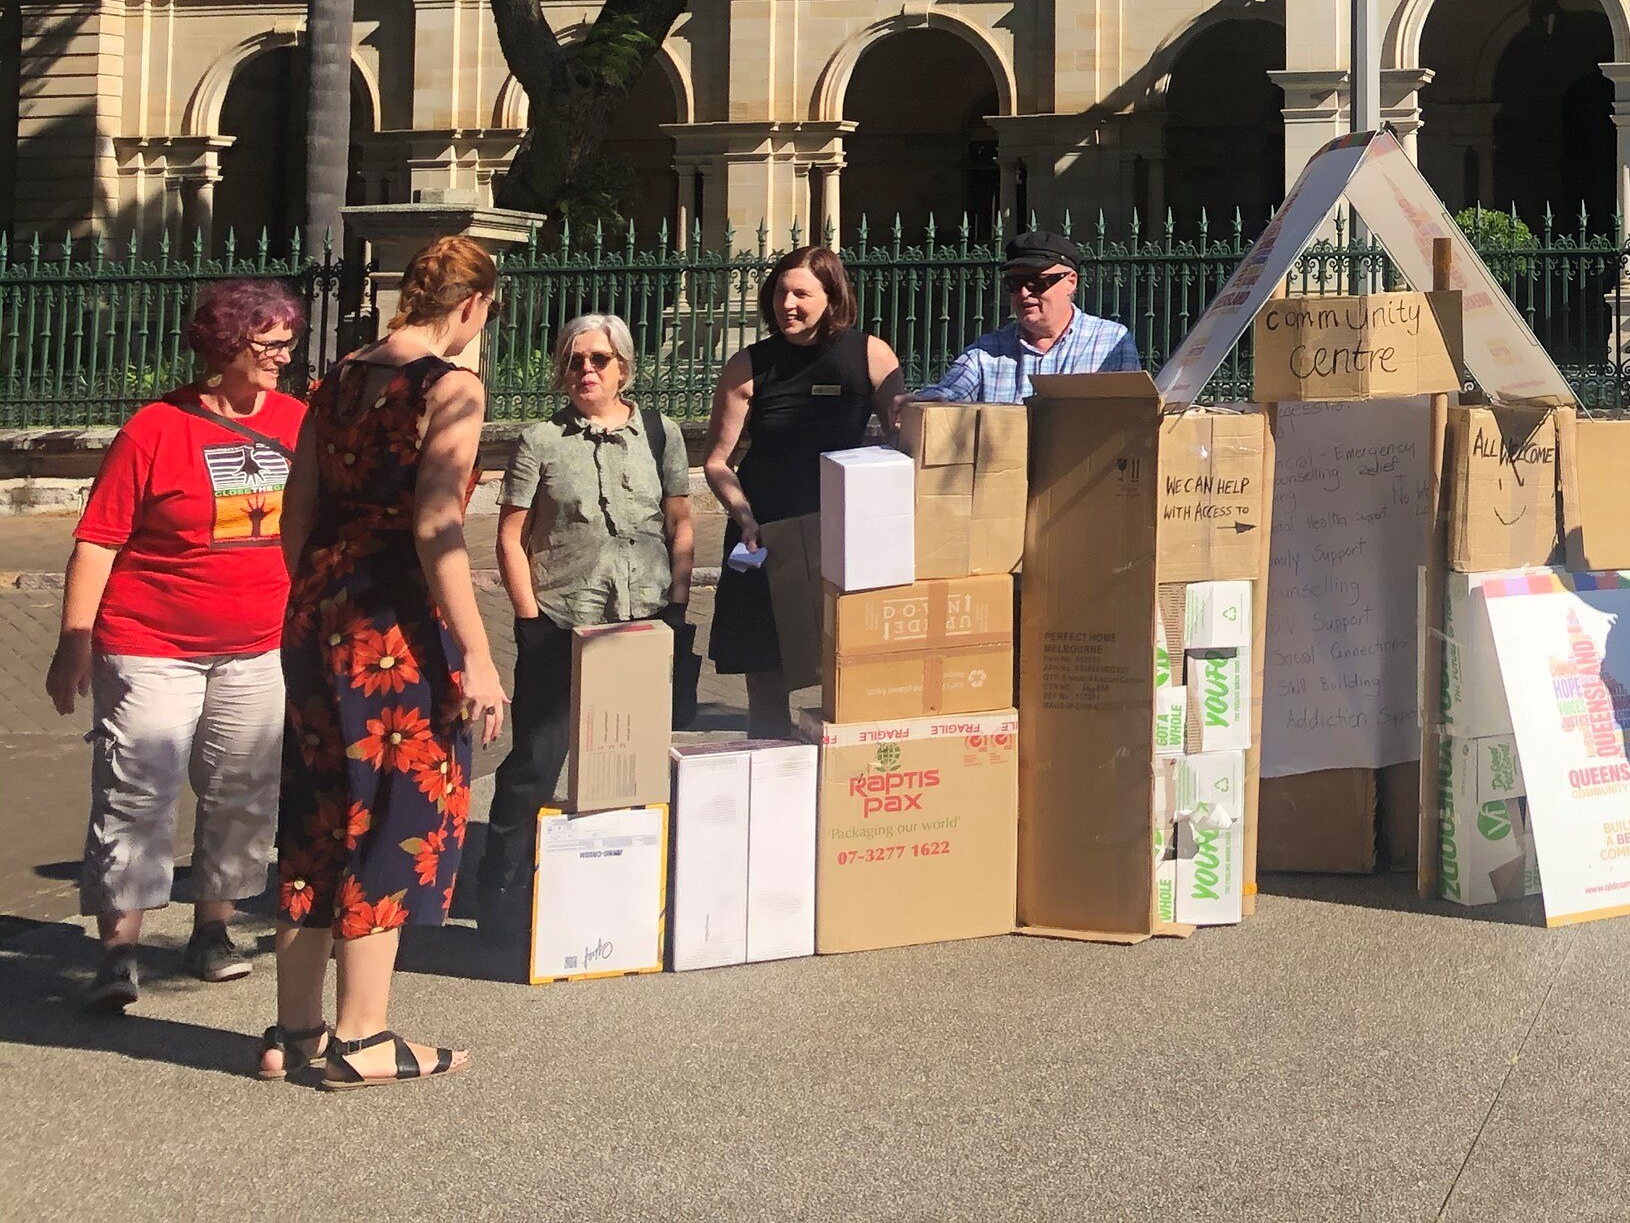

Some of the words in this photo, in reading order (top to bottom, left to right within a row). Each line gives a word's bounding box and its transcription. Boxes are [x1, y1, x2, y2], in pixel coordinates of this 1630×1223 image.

[1335, 442, 1416, 461] Emergency
[1473, 427, 1498, 459] ALL
[1166, 475, 1181, 496] WE
[1184, 475, 1213, 494] CAN
[1217, 477, 1250, 495] HELP
[1164, 504, 1191, 521] WITH
[1195, 501, 1232, 521] ACCESS
[1236, 506, 1250, 515] TO
[1312, 537, 1366, 566] Support
[1312, 605, 1374, 634] Support
[1044, 632, 1087, 642] PERFECT
[1043, 644, 1103, 654] MELBOURNE
[1553, 677, 1583, 699] HOPE
[1573, 640, 1618, 758] QUEENSLAND
[859, 728, 910, 742] FRAGILE
[930, 722, 981, 735] FRAGILE
[1169, 704, 1183, 746] WHOLE
[1156, 725, 1169, 747] GOT
[1572, 783, 1629, 799] COMMUNITY
[897, 821, 918, 834] our
[1606, 835, 1614, 846] A
[837, 845, 906, 865] 07-3277
[911, 840, 950, 857] 1622
[1159, 879, 1172, 921] WHOLE
